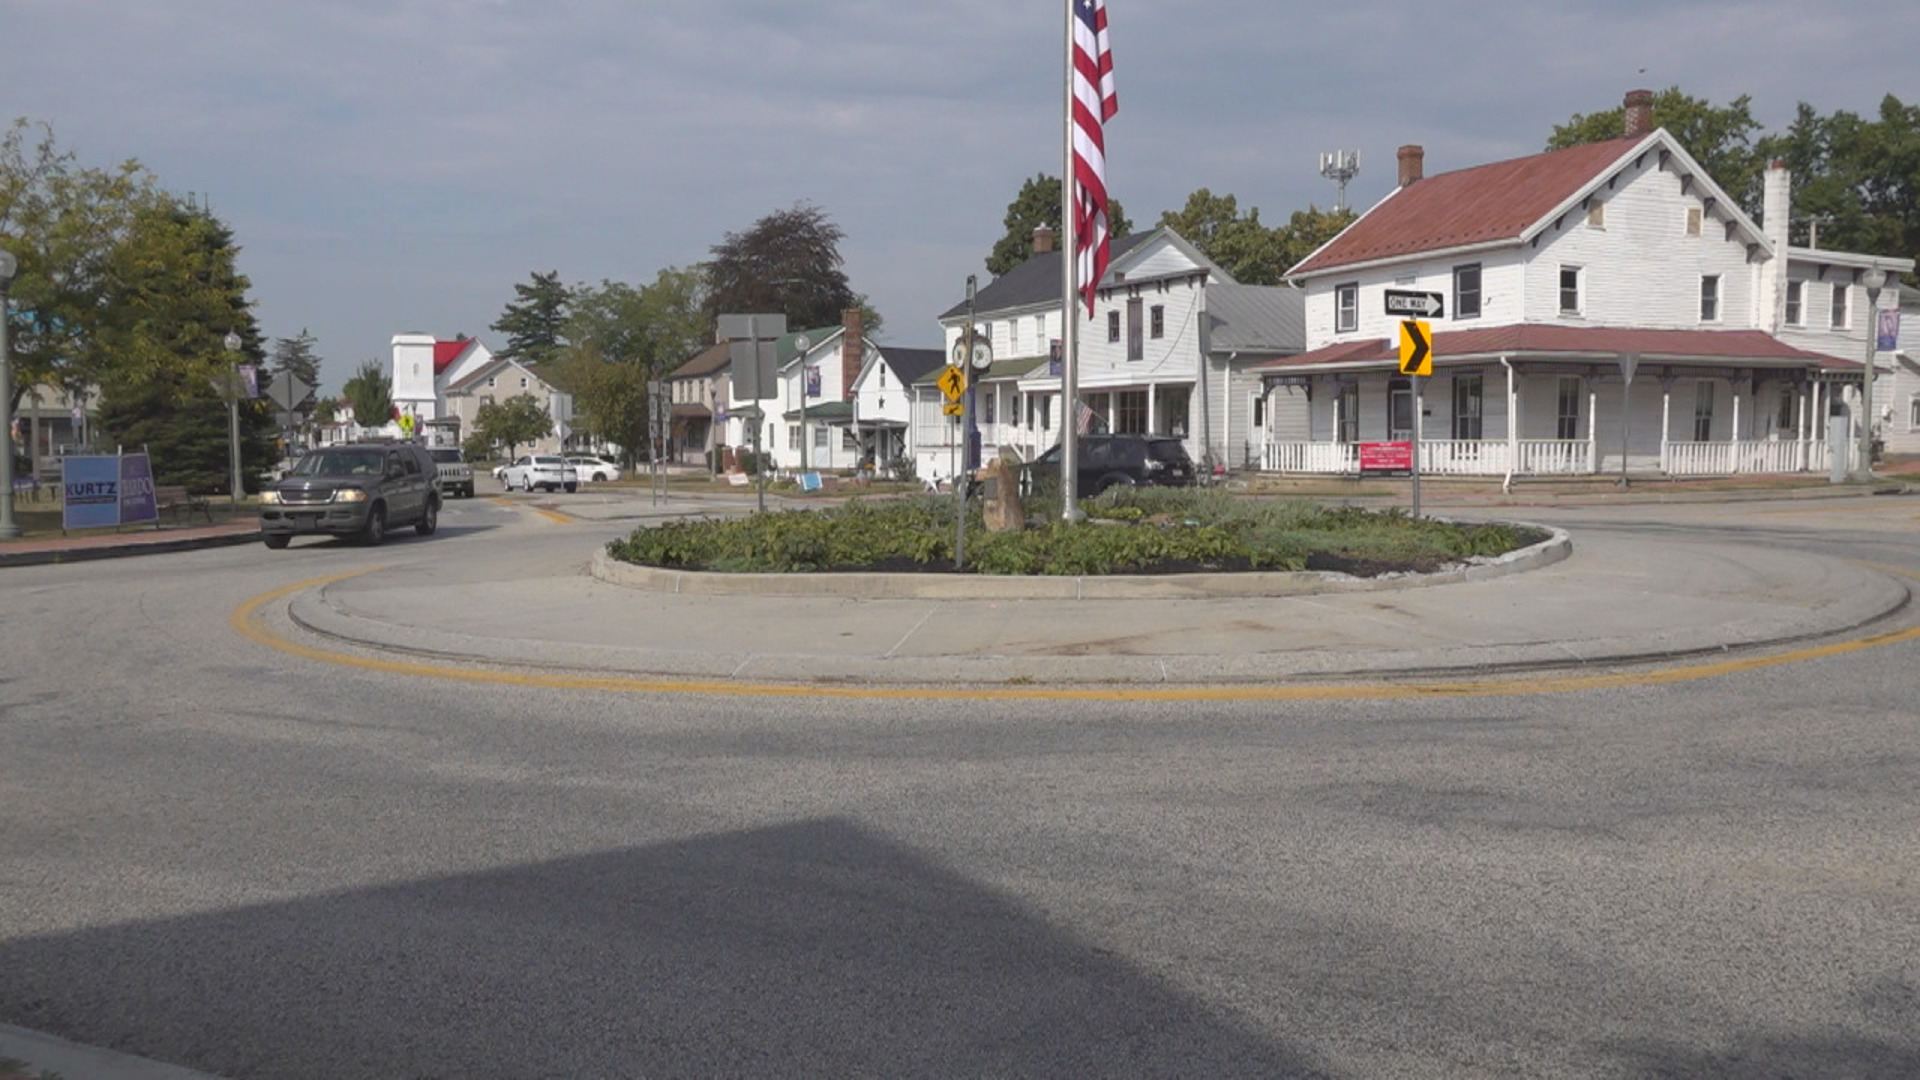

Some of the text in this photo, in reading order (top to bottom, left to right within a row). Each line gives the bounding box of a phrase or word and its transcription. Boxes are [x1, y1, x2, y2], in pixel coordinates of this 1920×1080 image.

[1390, 297, 1426, 309] ONE WAY
[66, 482, 117, 496] KURTZ
